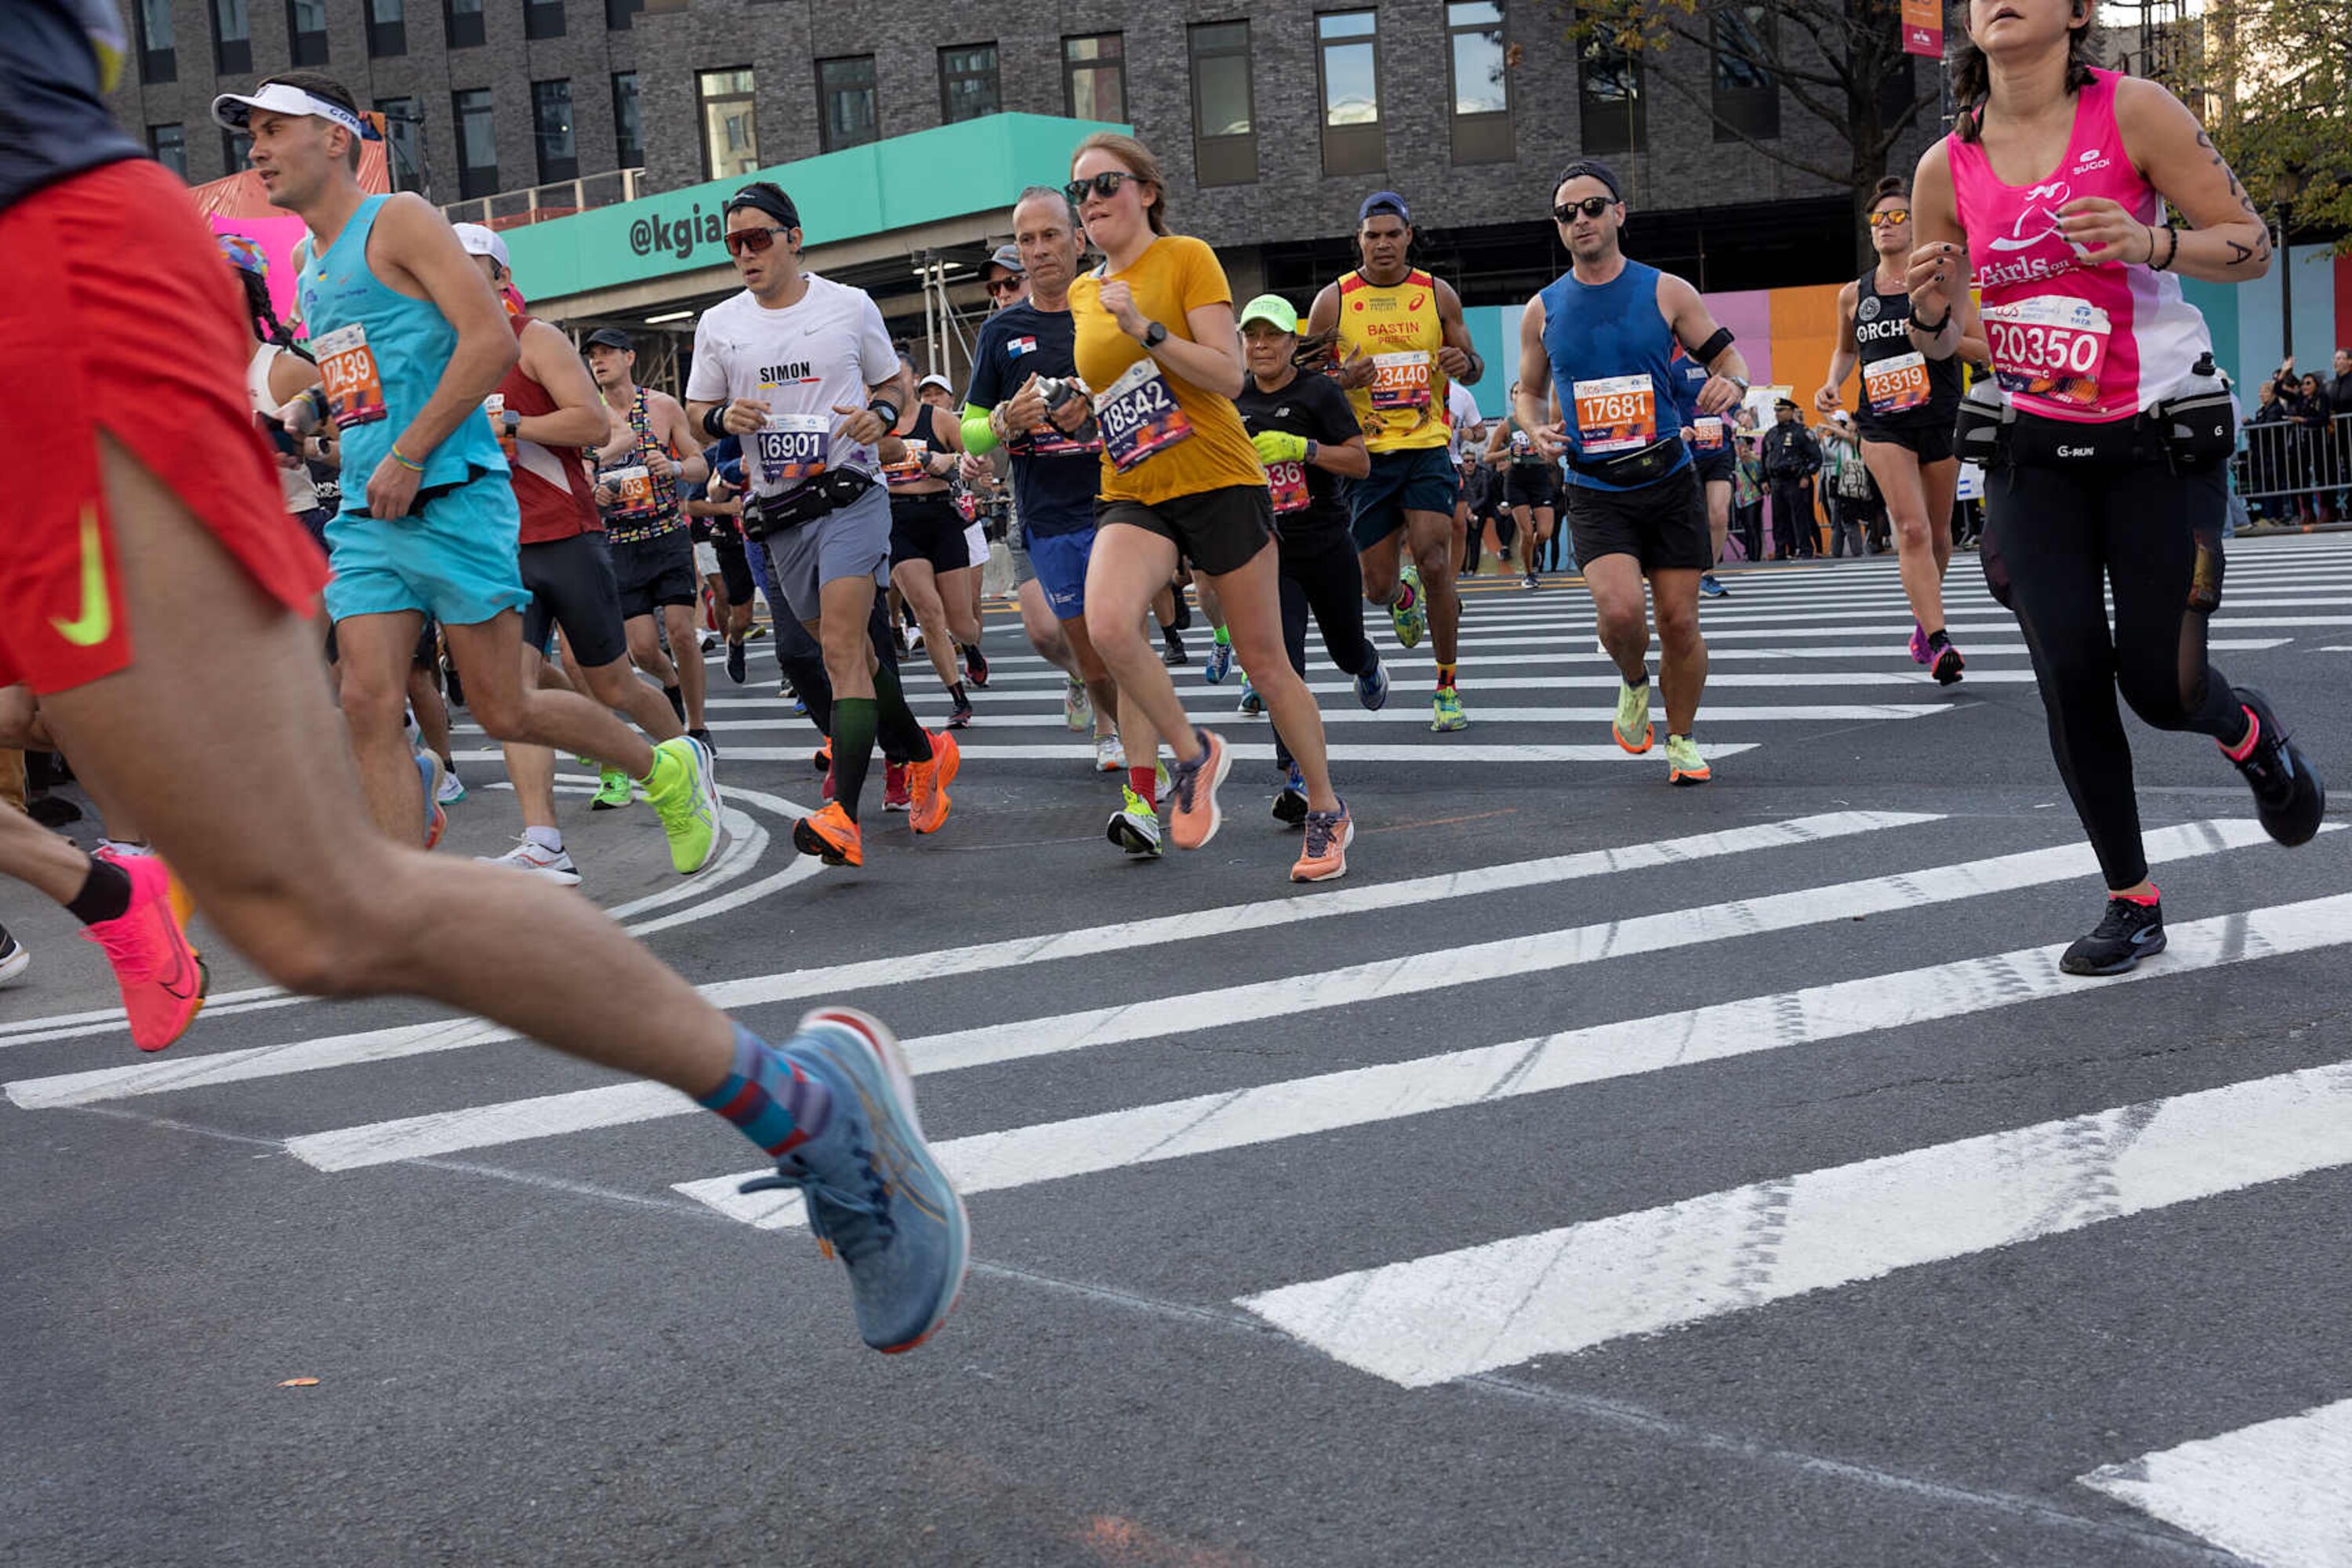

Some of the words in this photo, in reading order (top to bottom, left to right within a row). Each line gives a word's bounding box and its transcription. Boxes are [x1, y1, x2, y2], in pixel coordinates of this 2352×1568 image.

[1980, 255, 2053, 289] Girls
[2050, 260, 2071, 270] on
[1367, 321, 1420, 336] BASTIN
[1857, 318, 1908, 343] ORCH
[2070, 316, 2092, 326] TATA
[1991, 323, 2099, 372] 20350
[760, 361, 811, 383] SIMON
[1372, 365, 1428, 387] 23440
[1869, 367, 1922, 397] 23319
[1103, 380, 1171, 437] 18542
[1584, 392, 1646, 422] 17681
[759, 433, 820, 459] 16901
[2056, 445, 2095, 457] G-RUN
